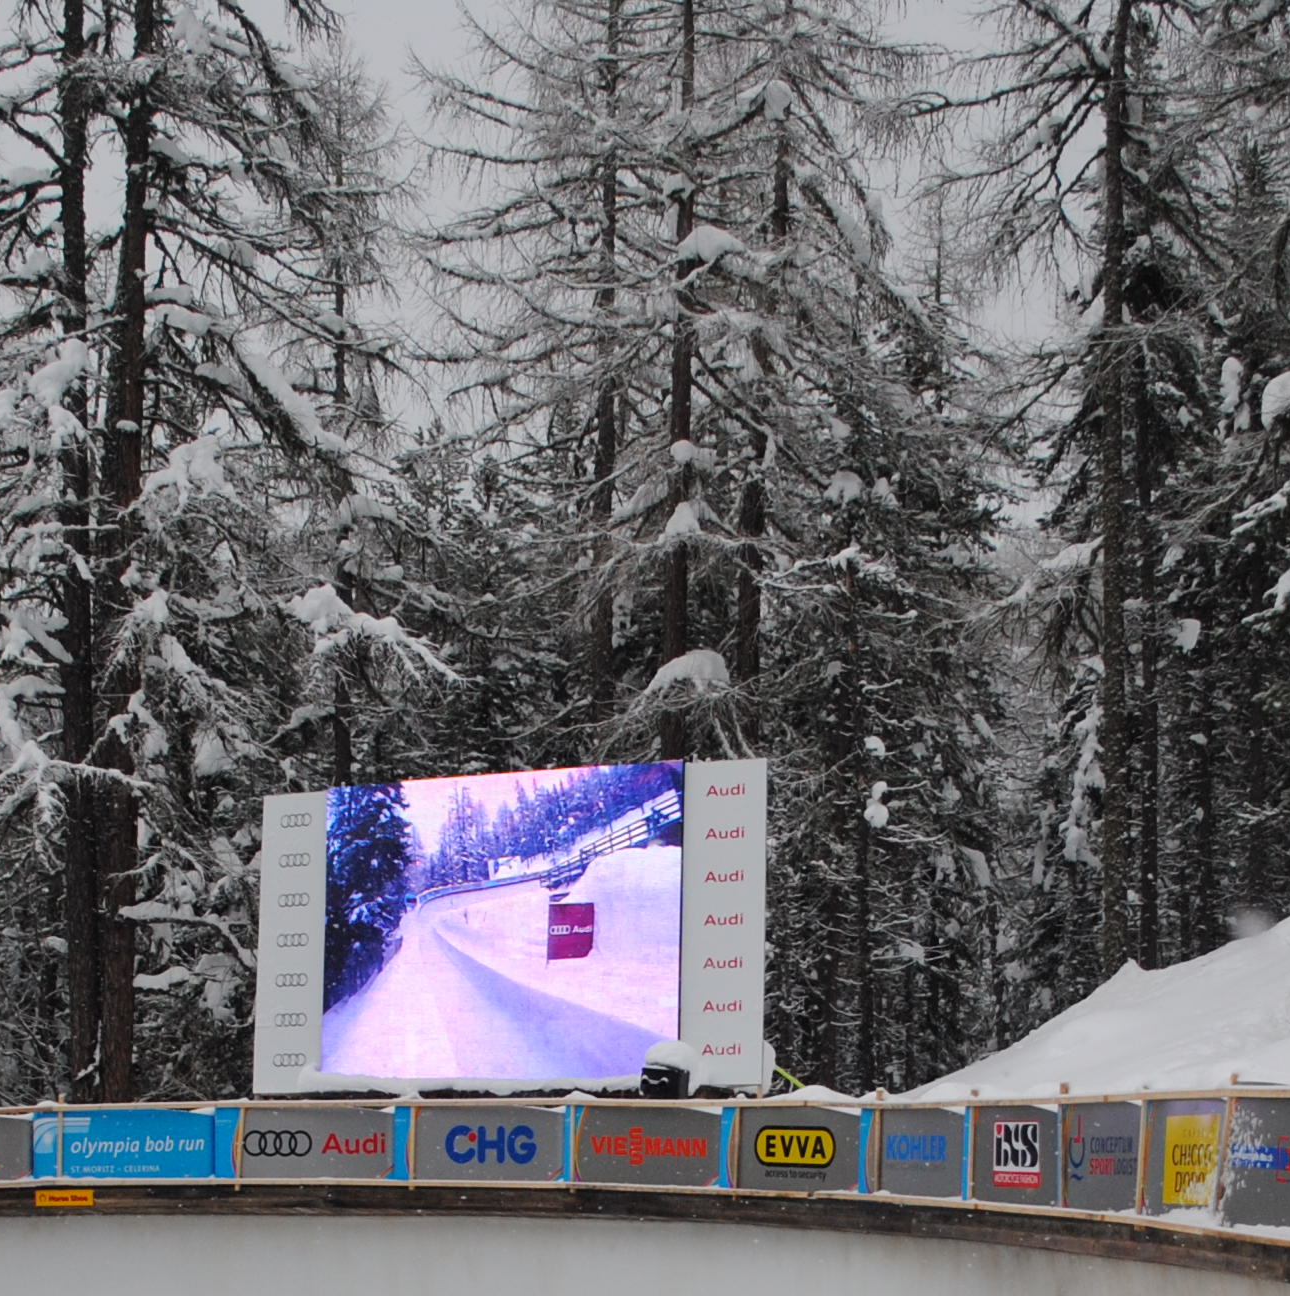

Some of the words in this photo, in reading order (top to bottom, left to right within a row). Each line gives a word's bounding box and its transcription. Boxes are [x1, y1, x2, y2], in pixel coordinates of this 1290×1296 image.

[706, 783, 746, 797] Audi
[705, 826, 745, 840] Audi
[704, 869, 745, 883] Audi
[704, 913, 744, 927] Audi
[703, 956, 743, 970] Audi
[702, 1000, 742, 1013] Audi
[701, 1043, 741, 1057] Audi
[70, 1137, 140, 1159] olympia
[145, 1135, 173, 1152] bob
[178, 1137, 205, 1152] run
[321, 1133, 387, 1154] Audi
[445, 1125, 537, 1165] CHG
[591, 1127, 708, 1166] VIESSMANN
[766, 1135, 826, 1160] EVVA
[885, 1135, 949, 1161] KOHLER
[124, 1164, 160, 1173] CELERINA
